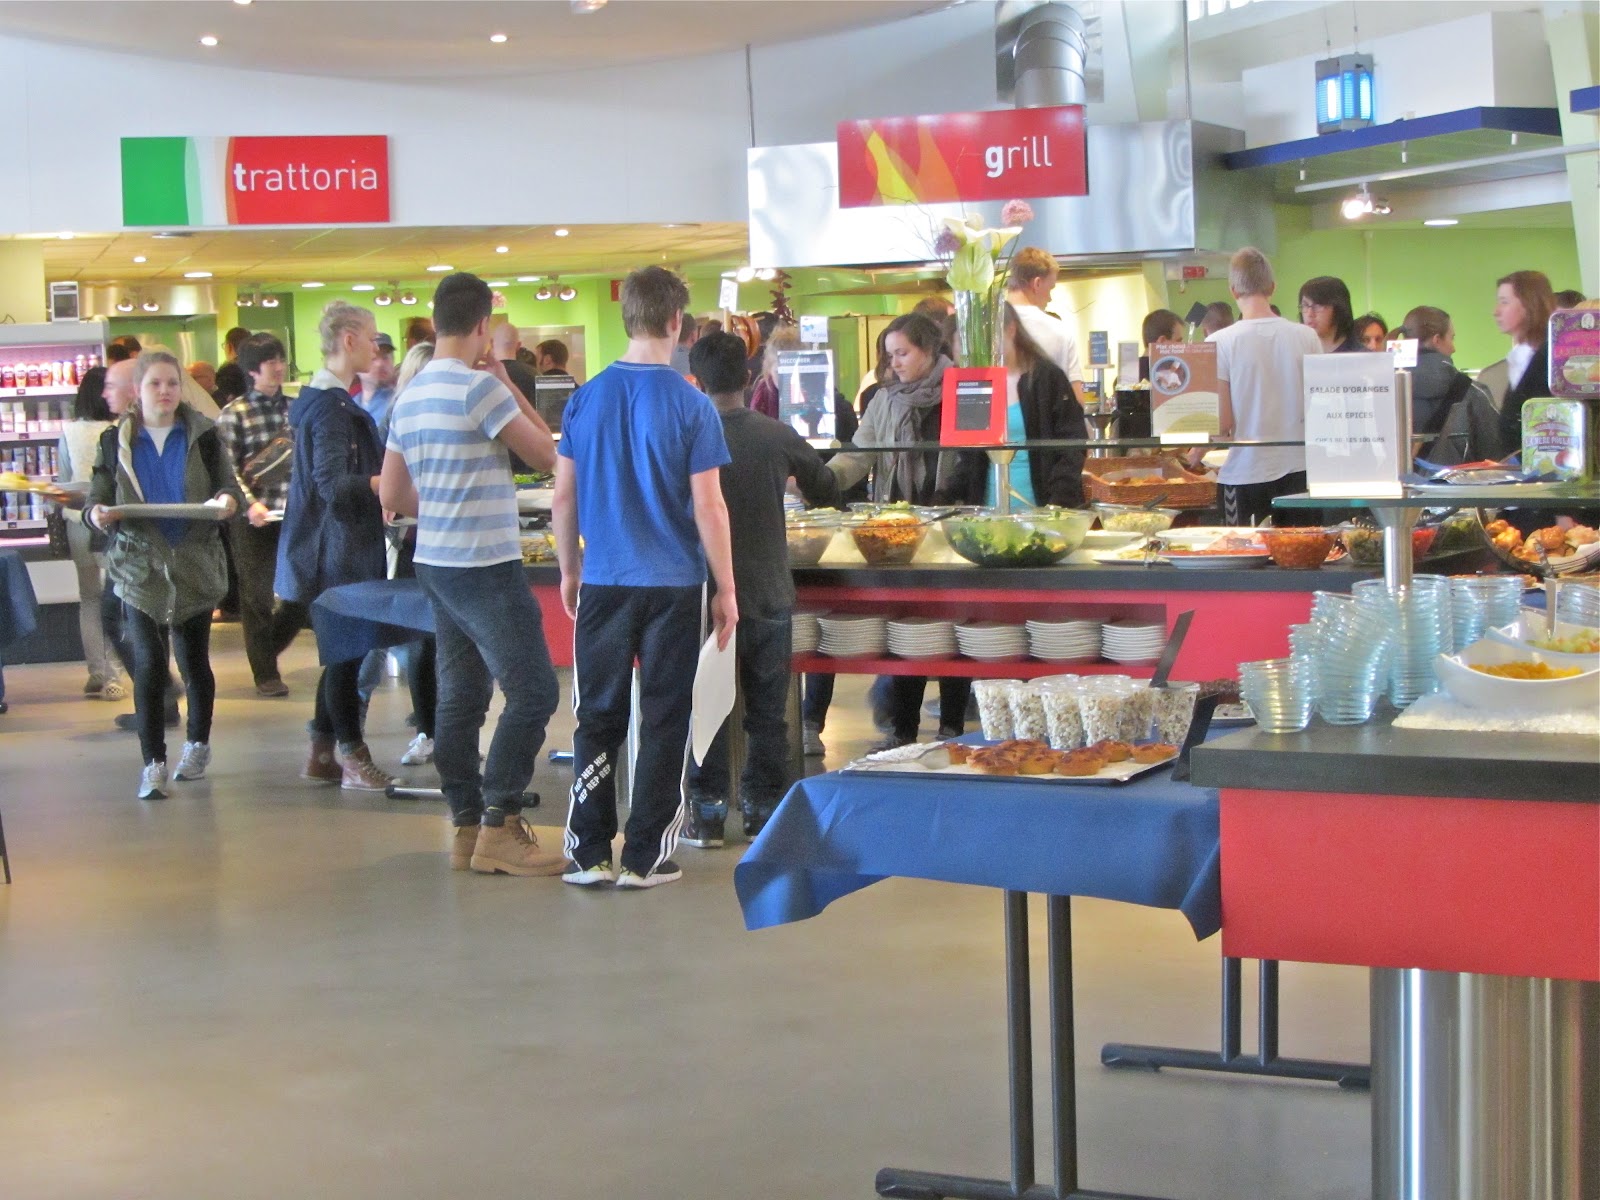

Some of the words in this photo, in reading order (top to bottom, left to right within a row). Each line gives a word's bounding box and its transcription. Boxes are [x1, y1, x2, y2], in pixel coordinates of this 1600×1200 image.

[984, 135, 1053, 178] grill
[233, 159, 379, 192] trattoria
[581, 763, 595, 780] HEP
[593, 751, 607, 767] HEP
